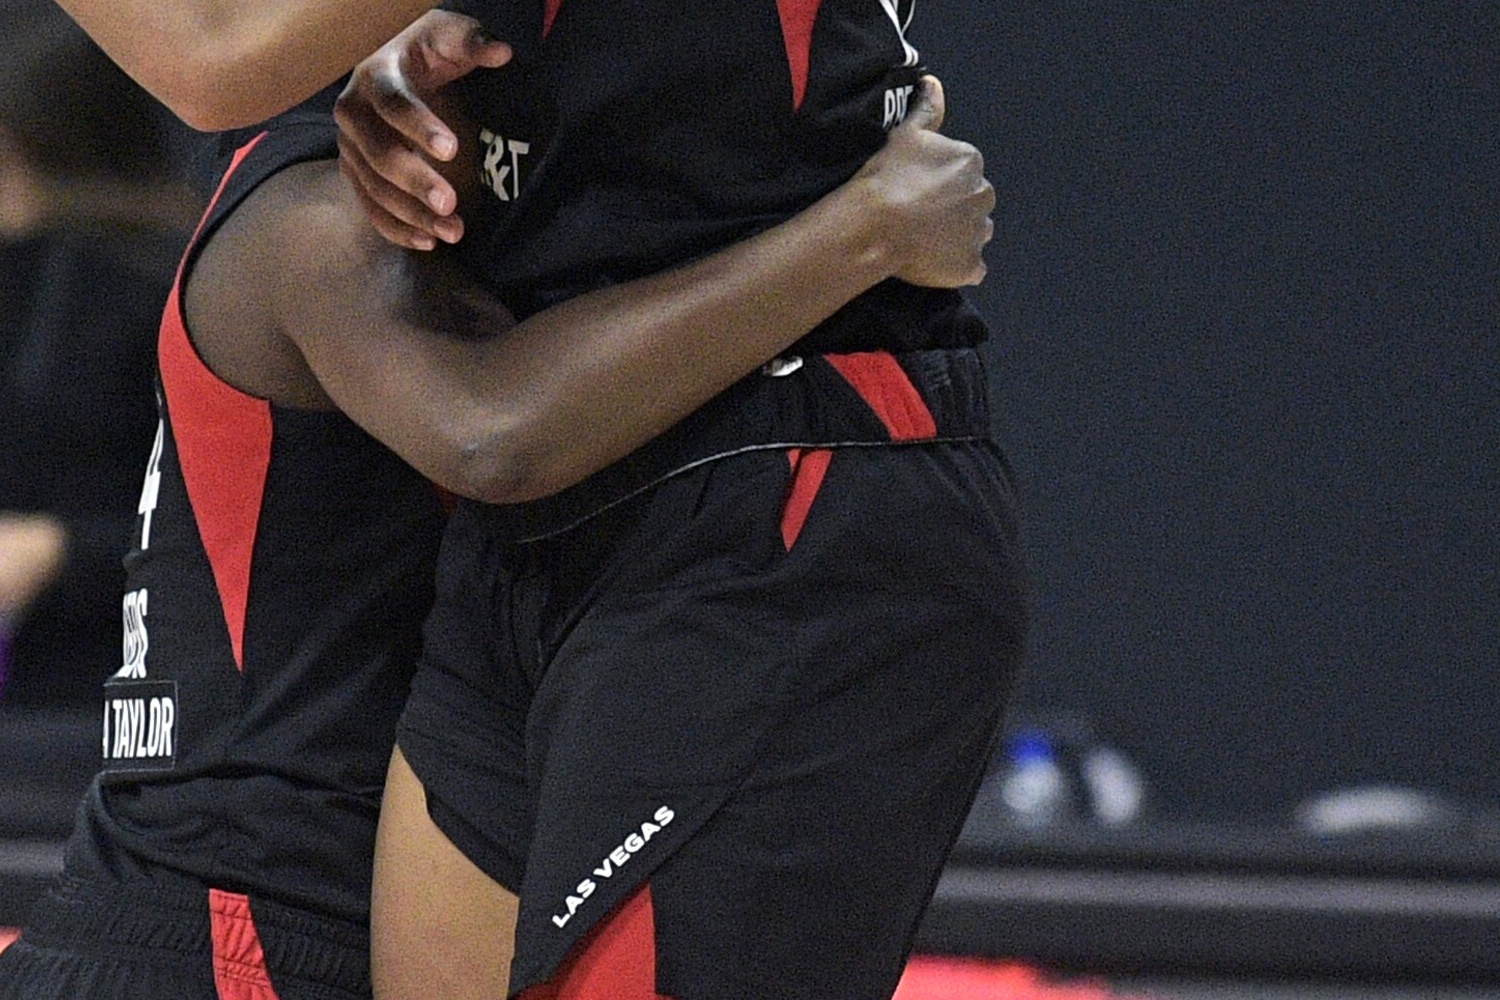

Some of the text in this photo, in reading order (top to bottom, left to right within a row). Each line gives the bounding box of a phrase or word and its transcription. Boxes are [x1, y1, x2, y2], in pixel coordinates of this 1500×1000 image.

[112, 697, 174, 758] TAYLOR
[552, 805, 675, 928] LAS VEGAS
